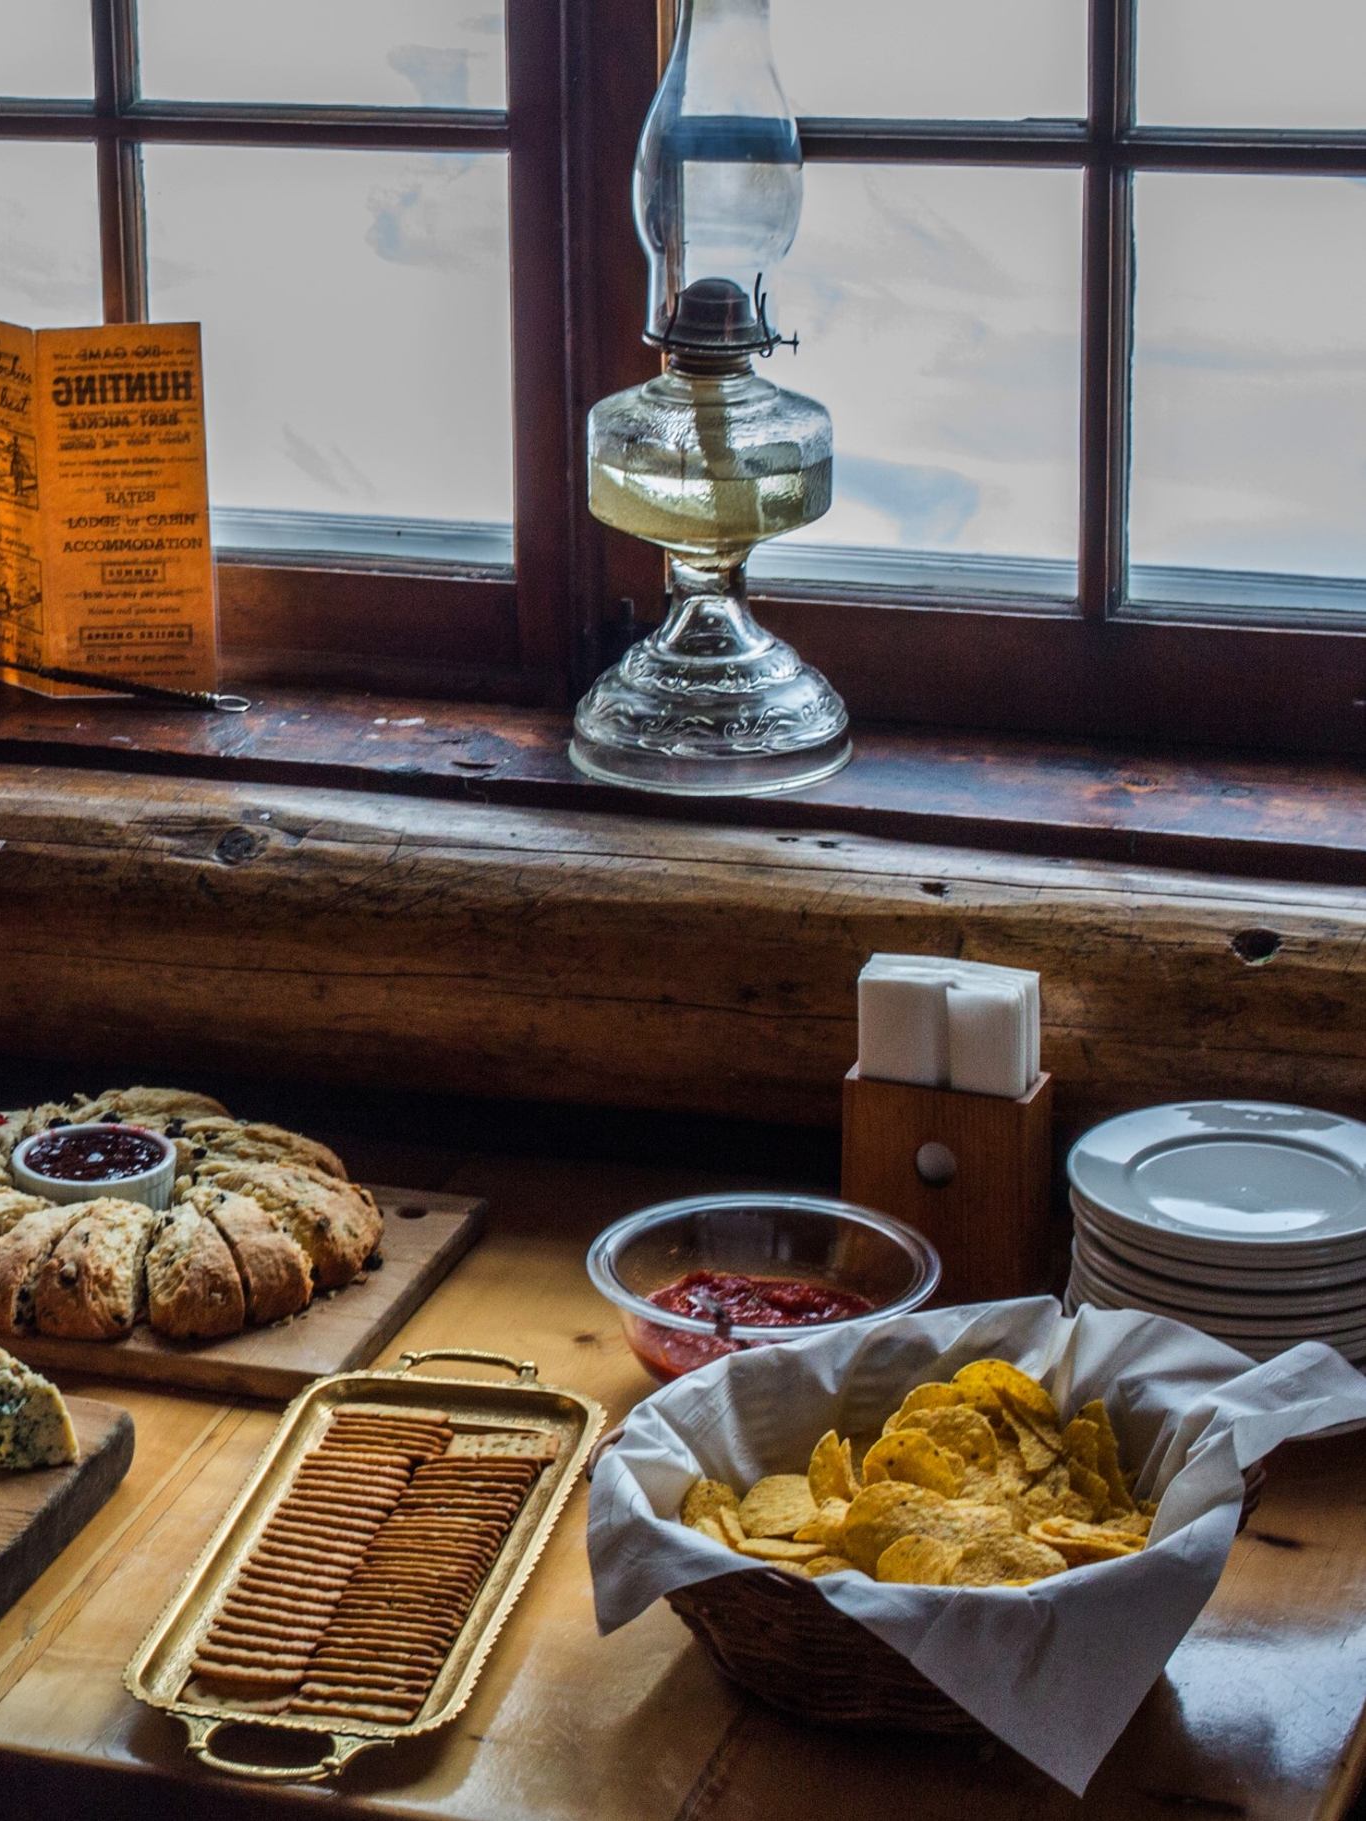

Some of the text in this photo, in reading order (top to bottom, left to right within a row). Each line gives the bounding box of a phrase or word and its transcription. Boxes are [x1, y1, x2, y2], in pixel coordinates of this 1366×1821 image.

[106, 491, 155, 503] RATES
[67, 516, 121, 529] LODGE
[146, 513, 196, 526] CABIN
[63, 538, 202, 553] ACCOMMODATION
[108, 568, 159, 578] SUMMER
[87, 630, 185, 640] SPRING SKIING
